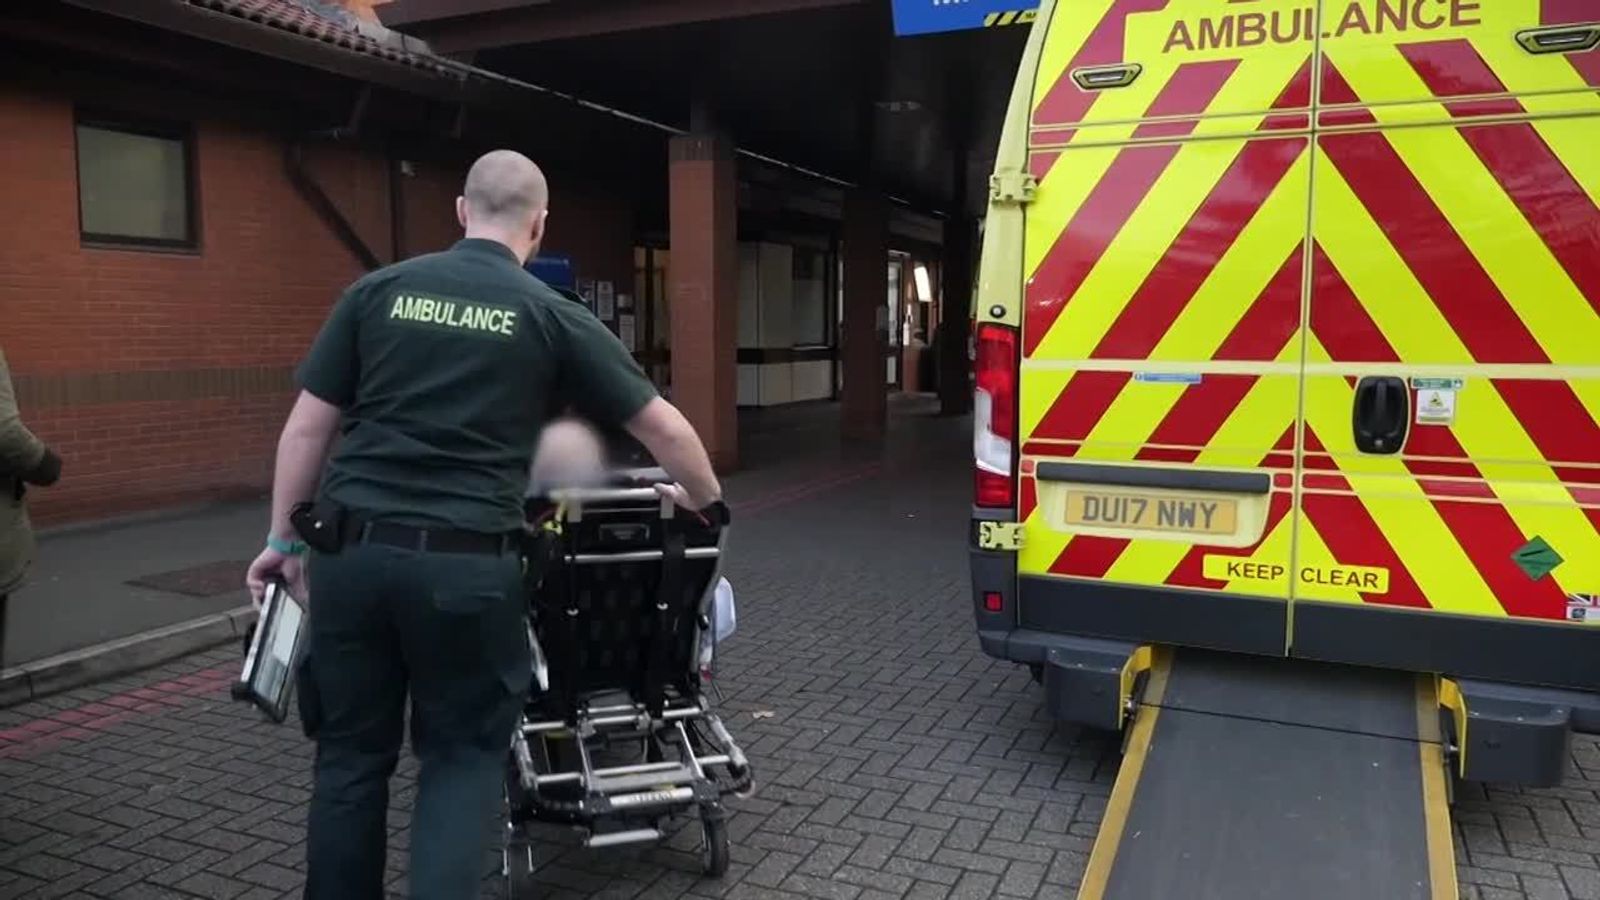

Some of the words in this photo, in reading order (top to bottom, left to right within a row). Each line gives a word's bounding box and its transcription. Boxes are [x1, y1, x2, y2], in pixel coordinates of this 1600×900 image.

[1162, 0, 1481, 53] AMBULANCE
[390, 295, 516, 336] AMBULANCE
[1082, 494, 1148, 524] DU17
[1157, 500, 1218, 529] NWY
[1227, 561, 1284, 581] KEEP
[1300, 566, 1378, 588] CLEAR
